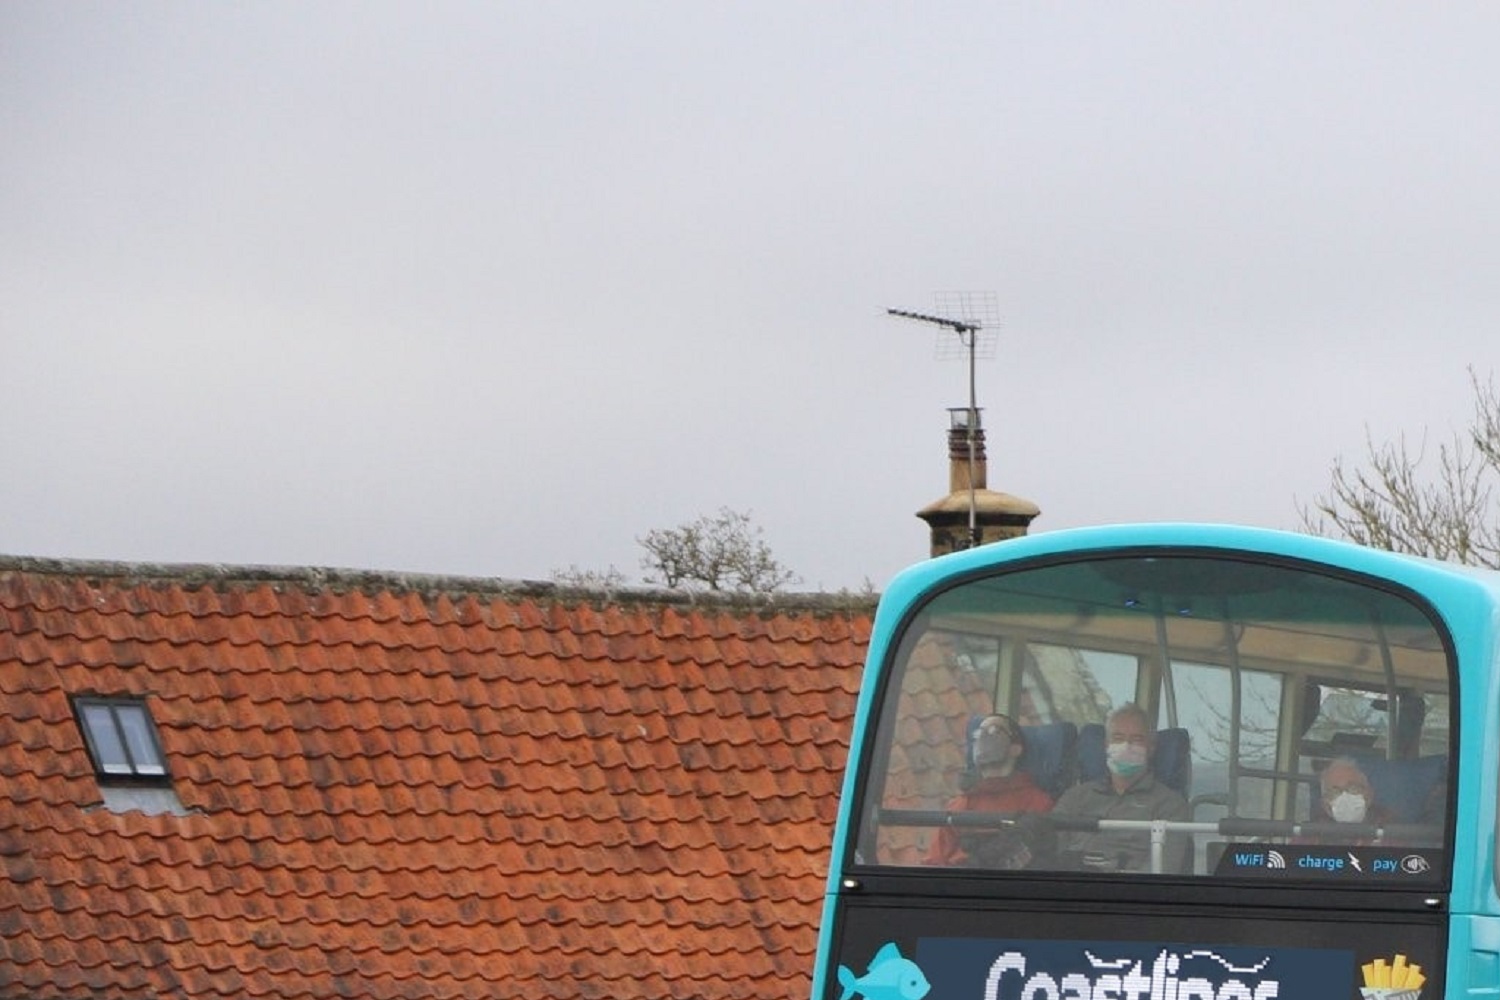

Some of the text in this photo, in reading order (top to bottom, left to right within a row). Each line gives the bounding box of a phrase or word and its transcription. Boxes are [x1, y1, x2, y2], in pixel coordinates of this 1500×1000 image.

[1235, 854, 1398, 873] WiFi charge pay
